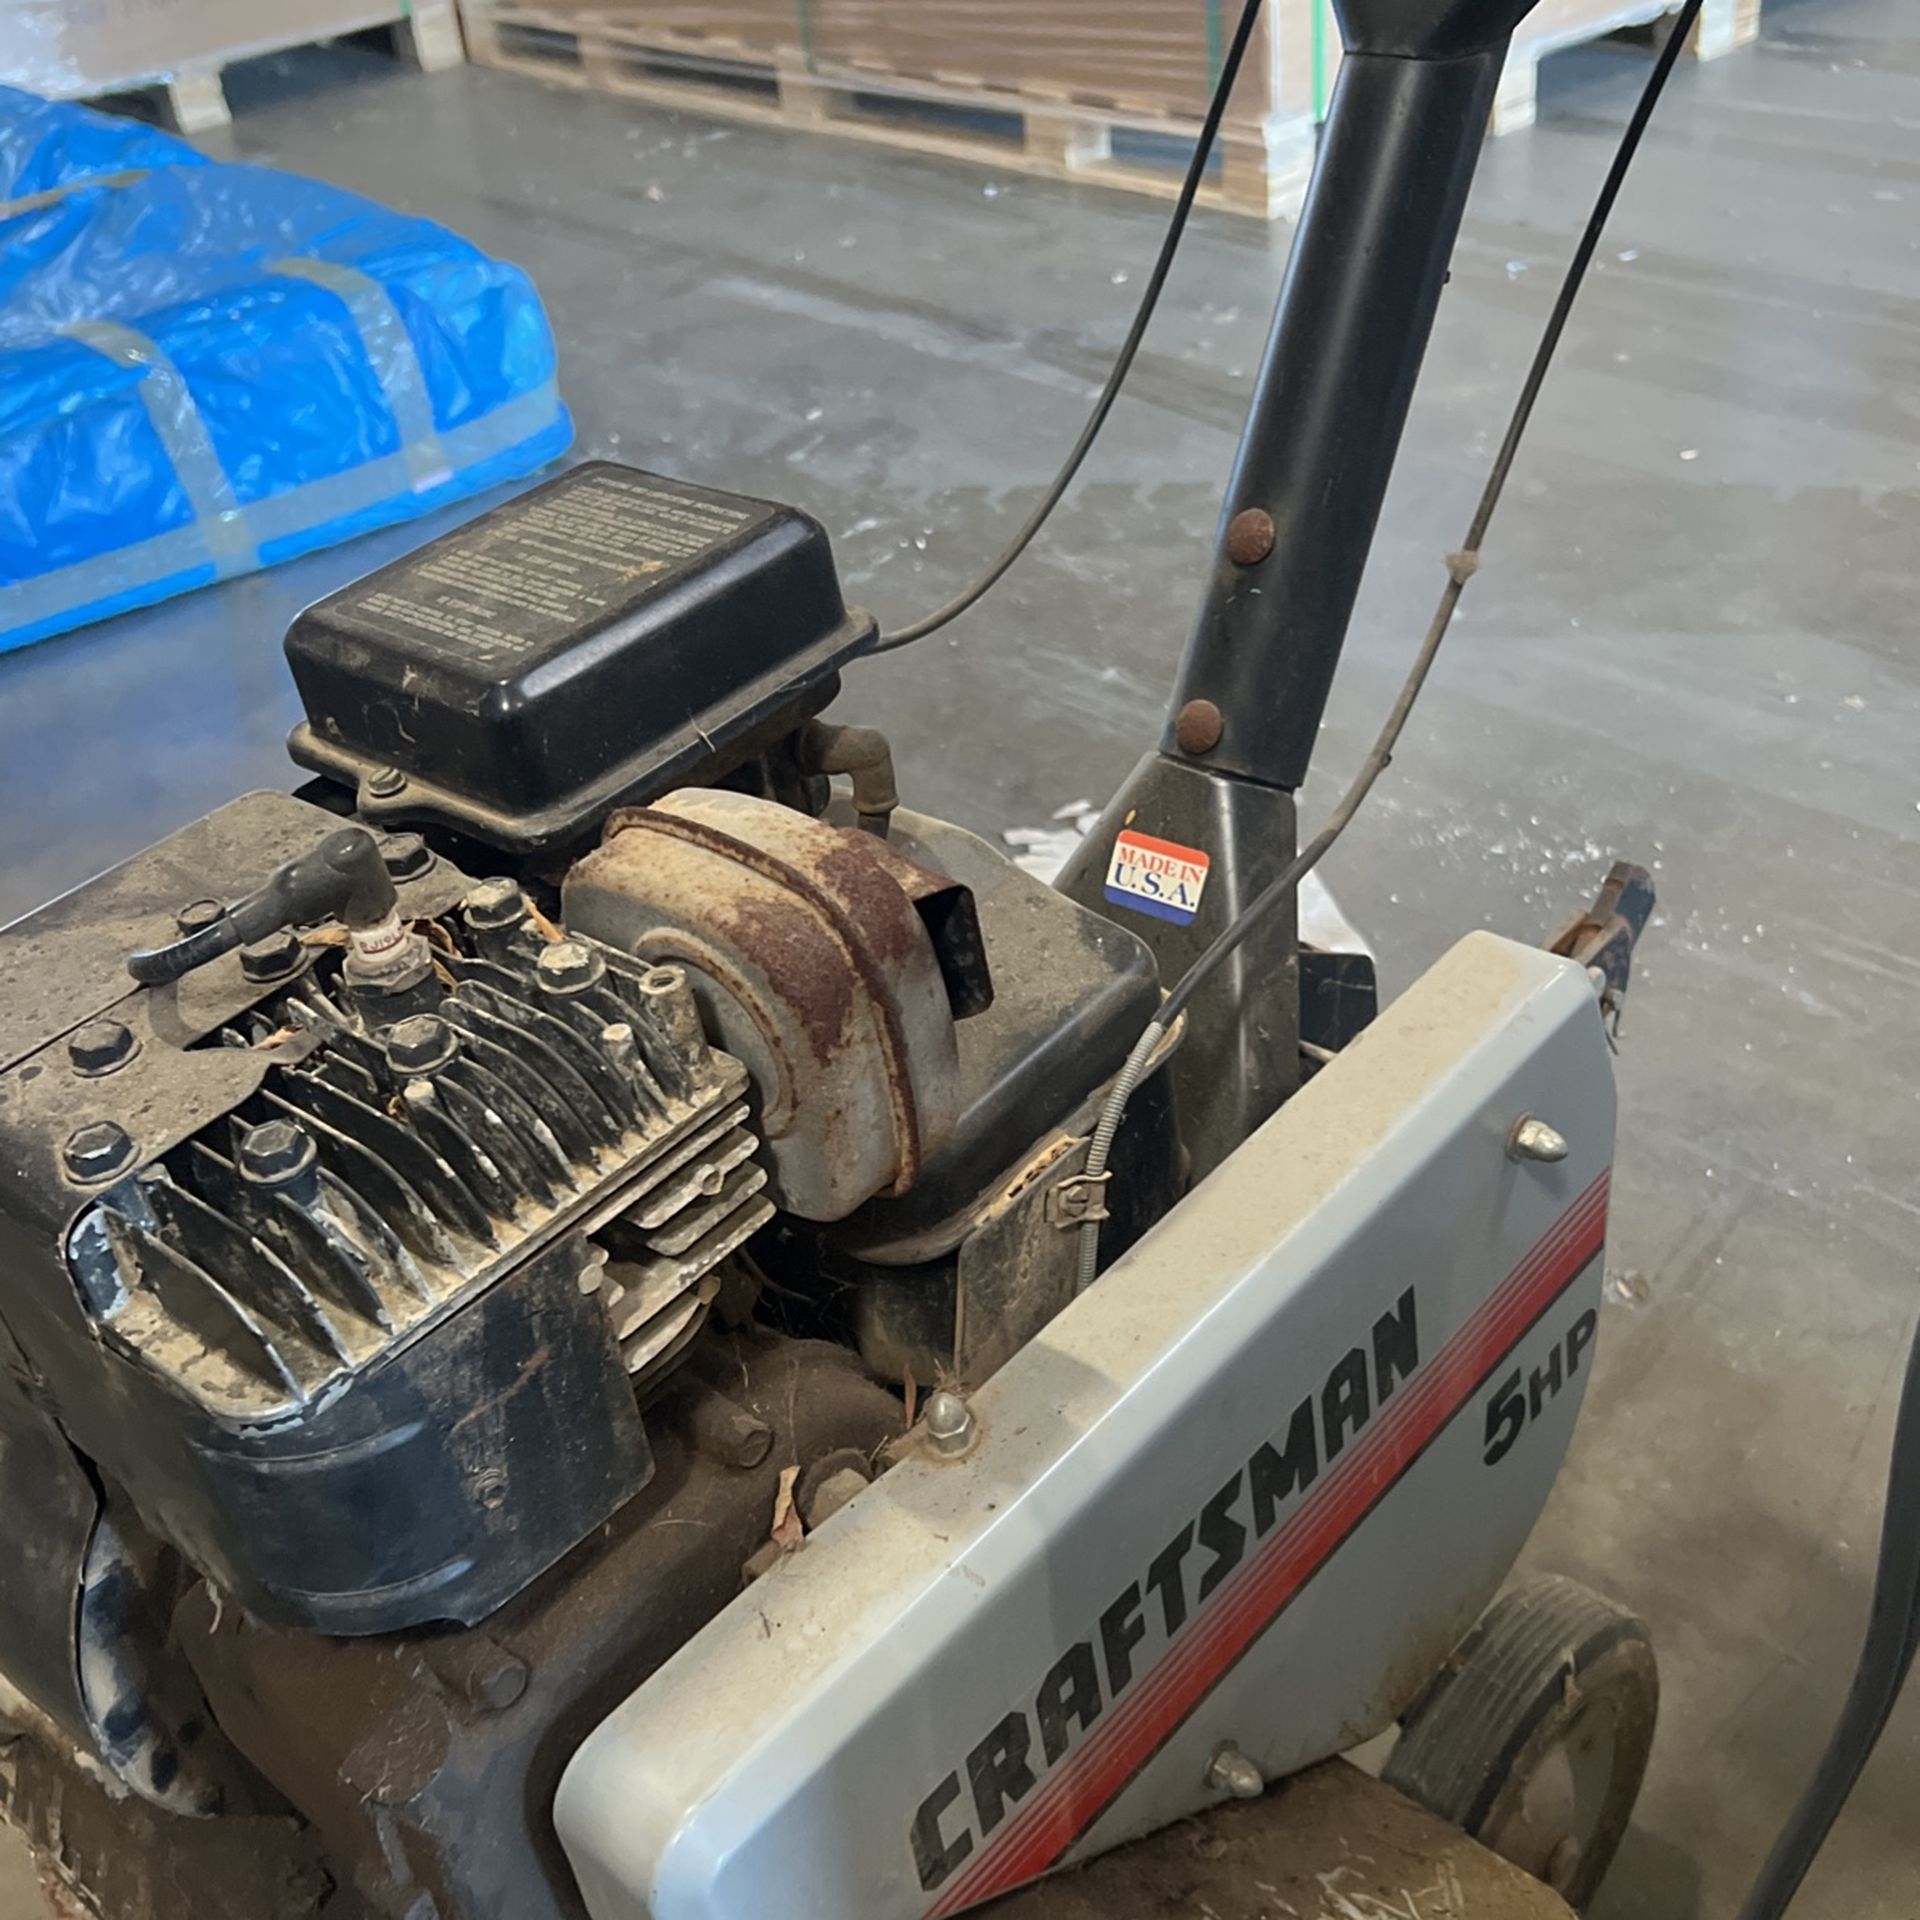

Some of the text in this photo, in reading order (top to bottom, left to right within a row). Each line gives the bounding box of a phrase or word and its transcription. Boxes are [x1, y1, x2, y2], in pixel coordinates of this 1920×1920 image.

[1115, 862, 1196, 908] U.S.A.
[1119, 846, 1205, 884] MADE IN
[1482, 1308, 1598, 1466] 5HP
[909, 1284, 1420, 1891] CRAFTSMAN
